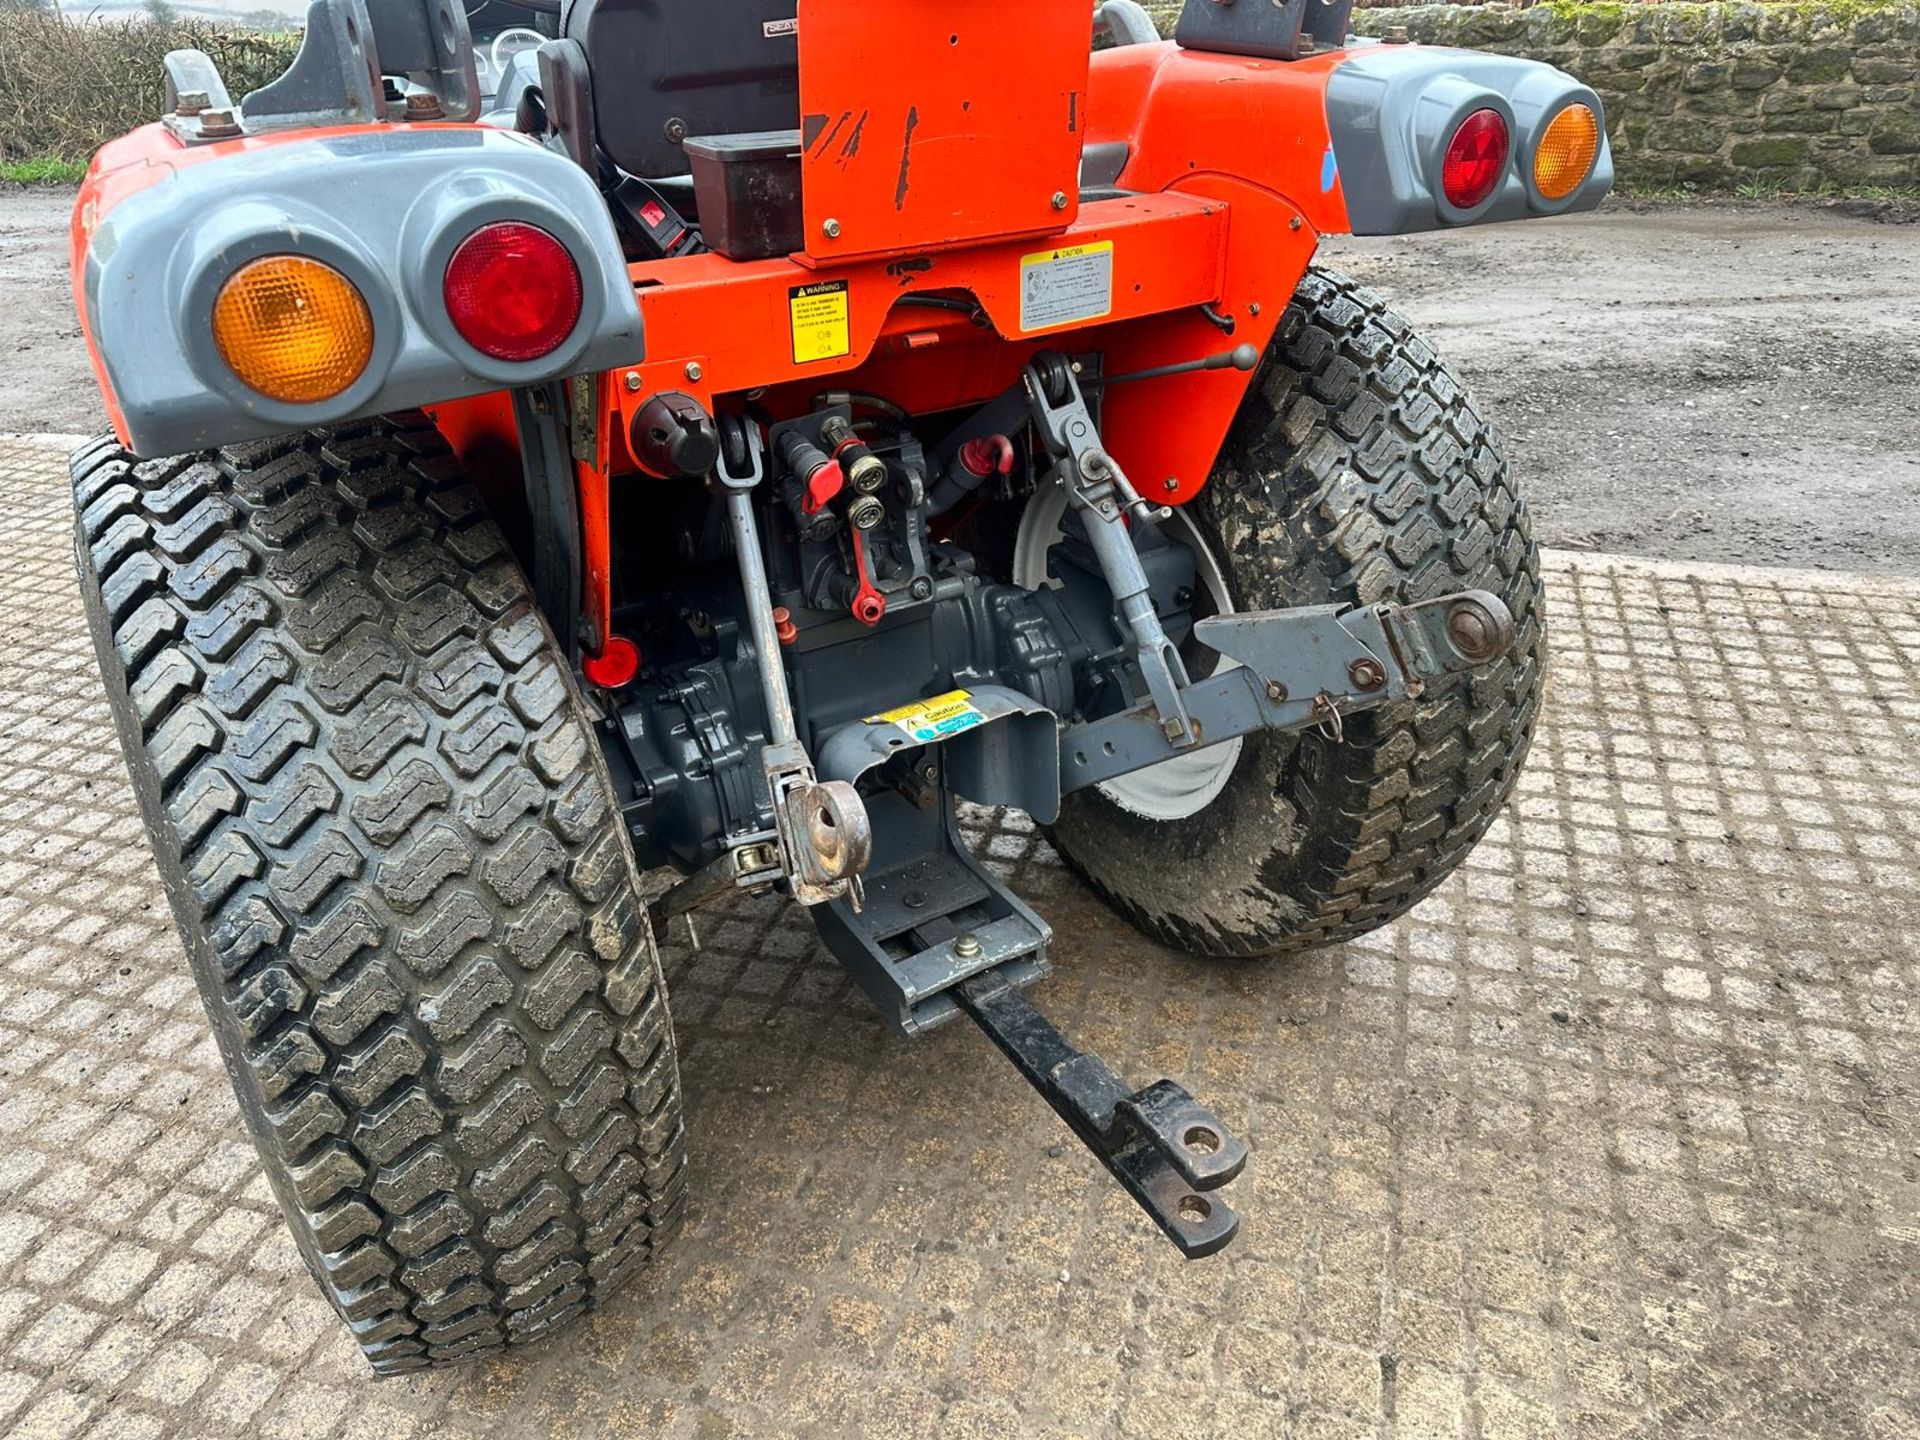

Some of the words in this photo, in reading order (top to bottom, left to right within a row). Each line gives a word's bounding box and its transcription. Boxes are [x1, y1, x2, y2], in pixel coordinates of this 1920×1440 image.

[1062, 248, 1083, 259] CAUTION
[806, 283, 840, 294] WARNING
[925, 703, 965, 720] Caution
